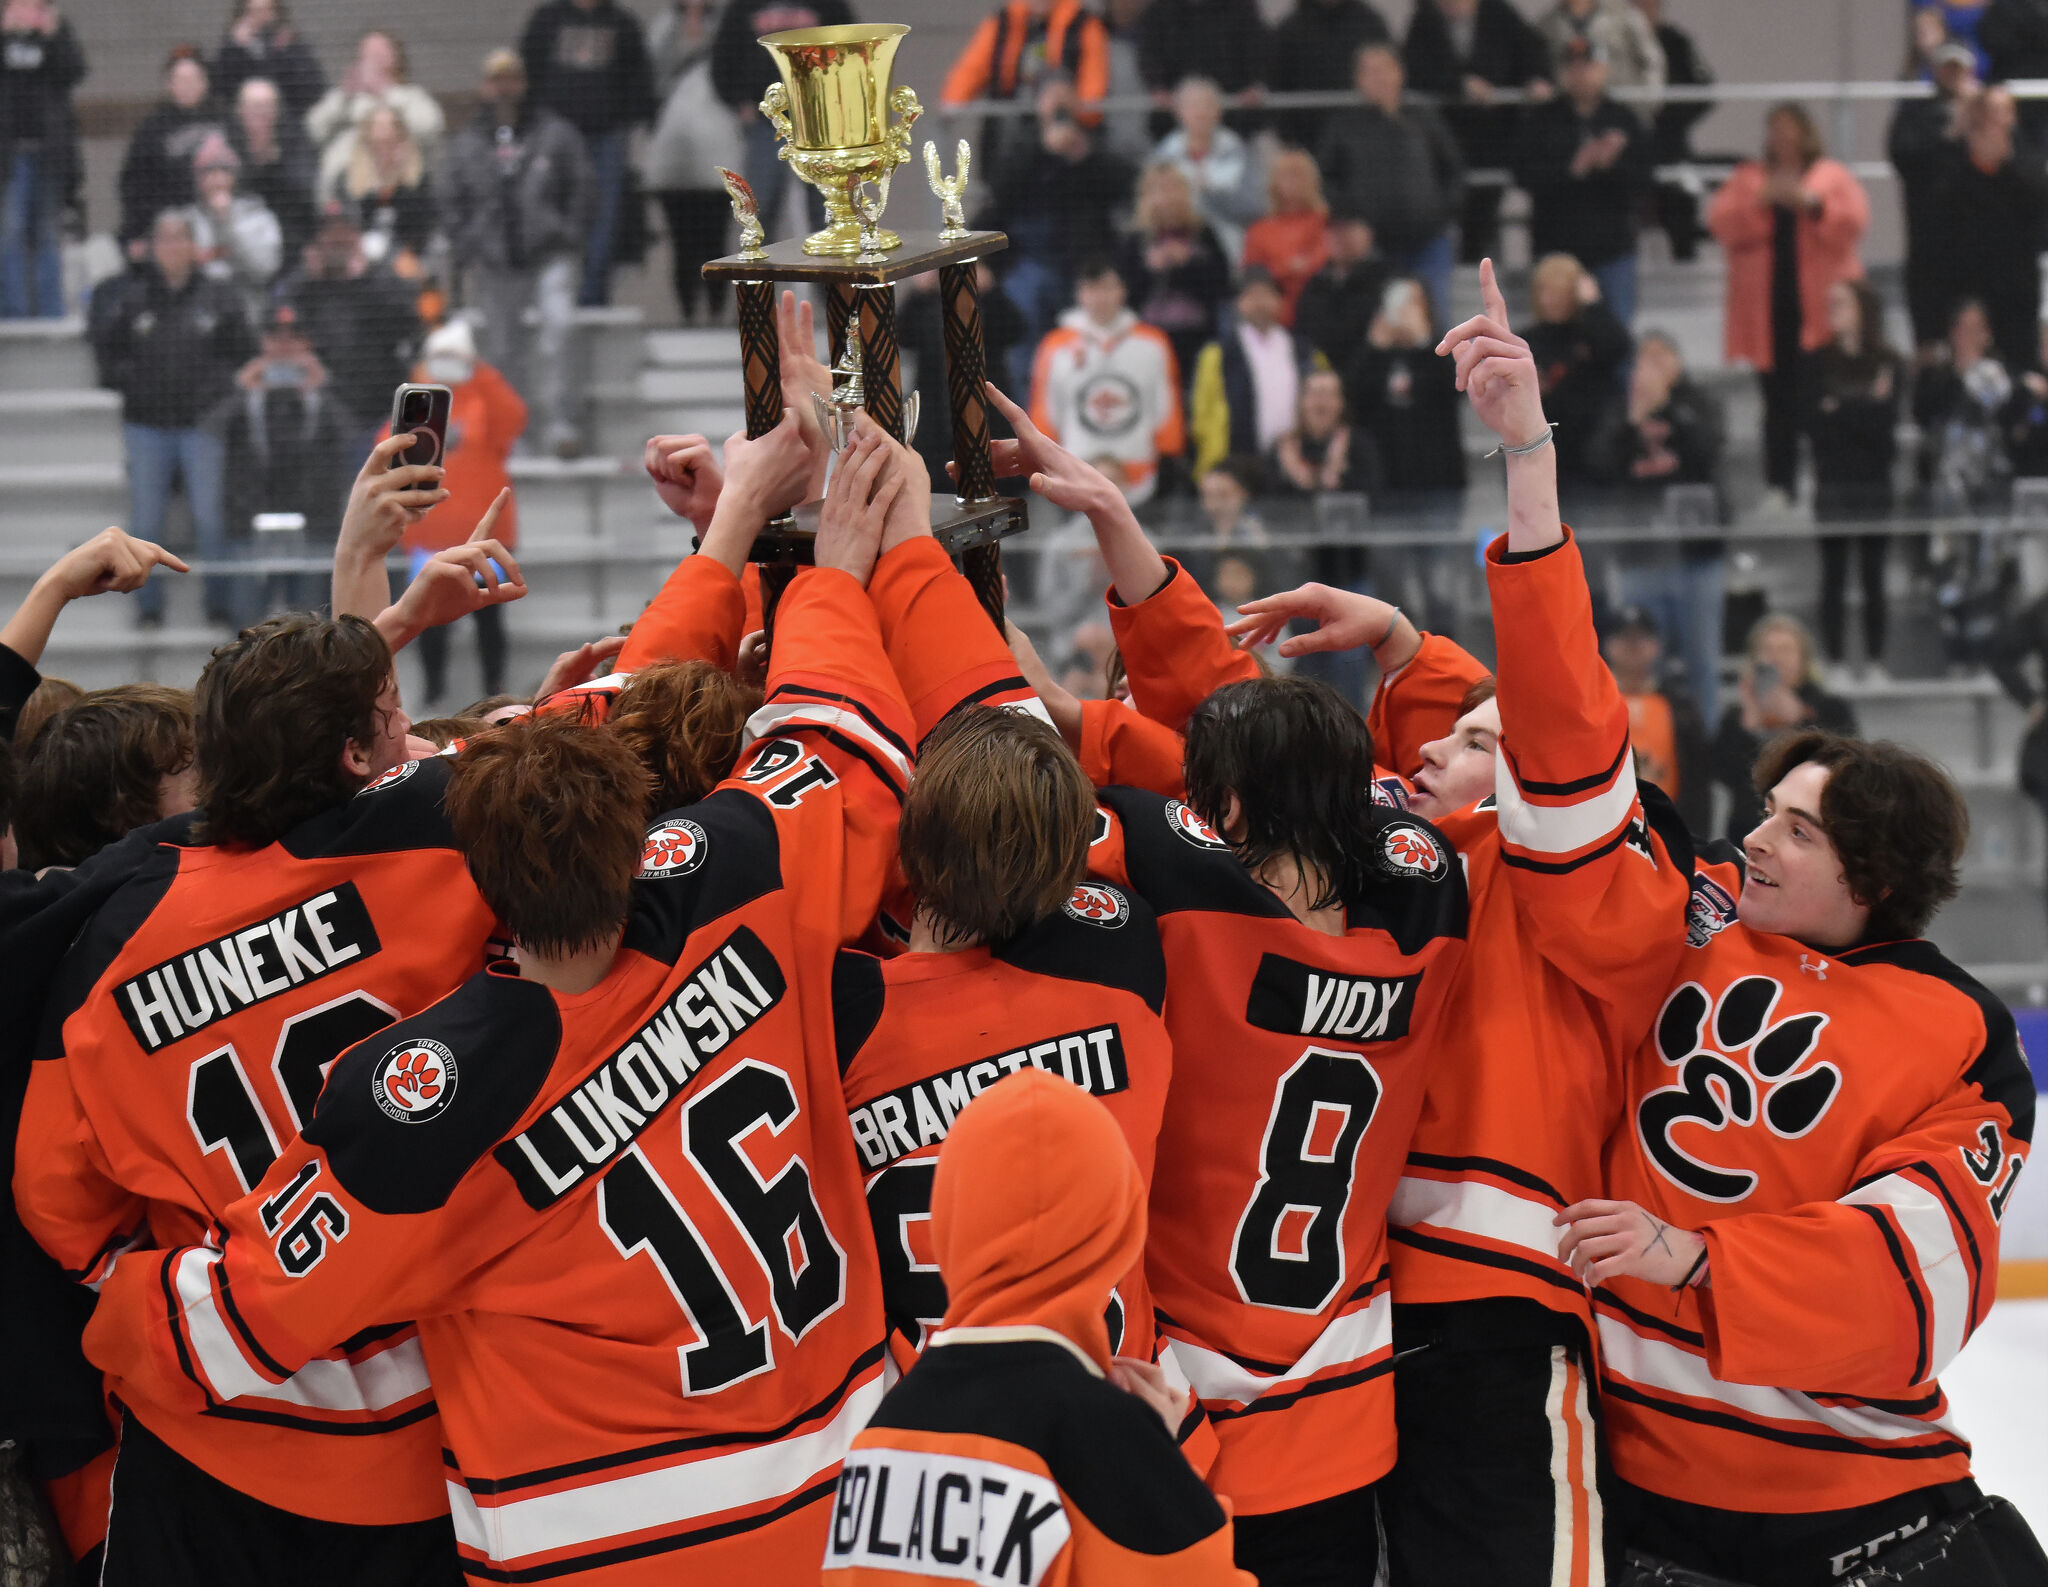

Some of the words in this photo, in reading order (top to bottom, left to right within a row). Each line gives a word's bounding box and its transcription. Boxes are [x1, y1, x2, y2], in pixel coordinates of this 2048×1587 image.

[741, 738, 840, 810] 16
[665, 820, 694, 830] SCHOOL
[691, 824, 705, 843] HIGH
[126, 891, 360, 1048] HUNEKE
[1300, 973, 1405, 1038] VIOX
[374, 1079, 386, 1100] HIGH
[381, 1099, 411, 1121] SCHOOL
[417, 1040, 456, 1081] EDWARDSVILLE
[515, 945, 773, 1196] LUKOWSKI
[258, 1158, 350, 1278] 16
[1228, 1045, 1383, 1315] 8
[1959, 1120, 2025, 1227] 31
[596, 1057, 847, 1398] 16
